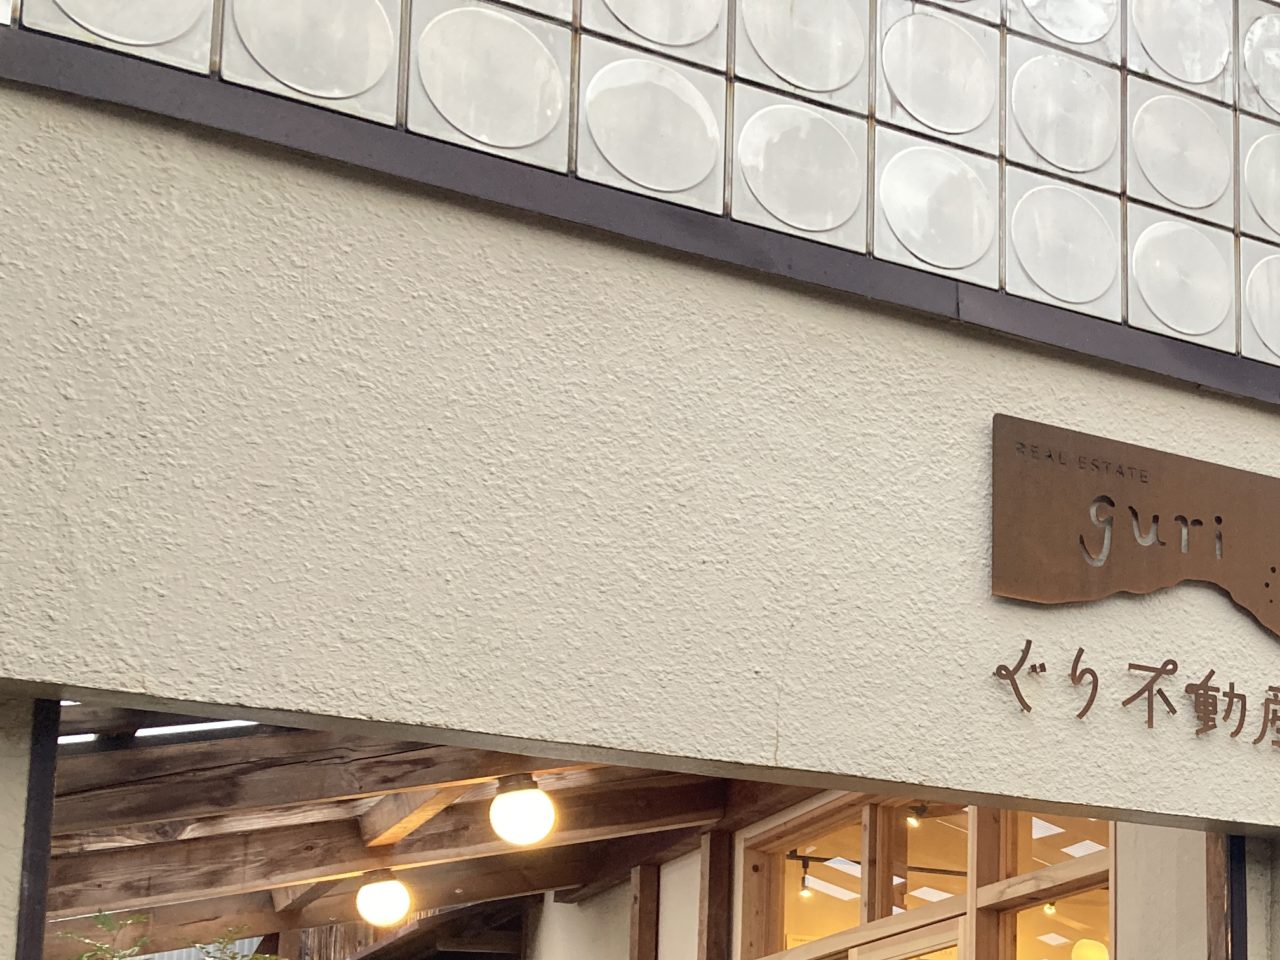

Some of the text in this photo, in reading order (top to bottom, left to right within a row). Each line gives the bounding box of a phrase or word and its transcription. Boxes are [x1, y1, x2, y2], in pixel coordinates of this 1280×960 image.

[1015, 441, 1149, 484] REAL ESTATE
[1079, 494, 1223, 568] guri
